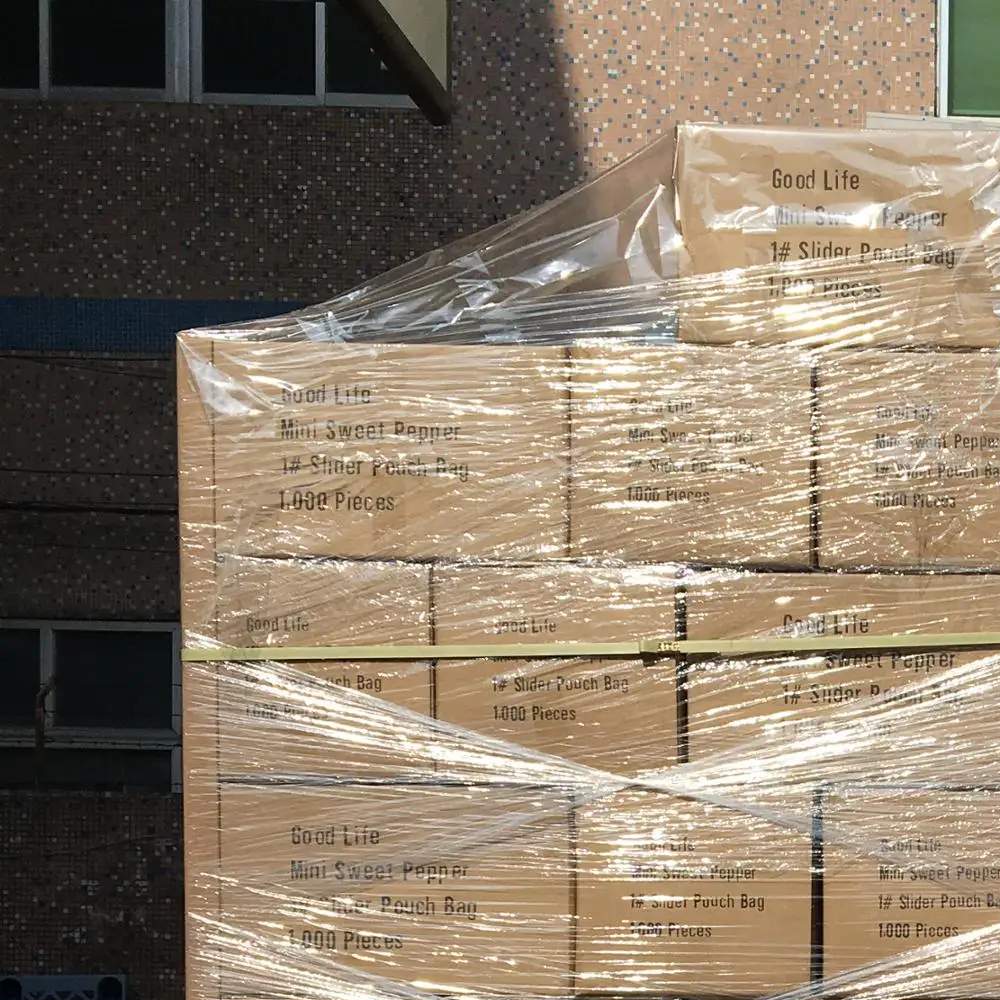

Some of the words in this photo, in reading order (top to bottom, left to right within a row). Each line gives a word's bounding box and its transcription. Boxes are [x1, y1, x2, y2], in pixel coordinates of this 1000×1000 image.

[772, 169, 814, 189] Good
[824, 170, 859, 191] Life
[798, 241, 851, 260] Slider
[335, 491, 394, 511] Pieces
[556, 675, 598, 691] Pouch
[604, 675, 629, 694] Bag
[532, 706, 576, 721] Pieces
[291, 826, 334, 845] Good
[344, 826, 380, 846] Life
[879, 894, 891, 910] 1#
[899, 894, 936, 910] Slider
